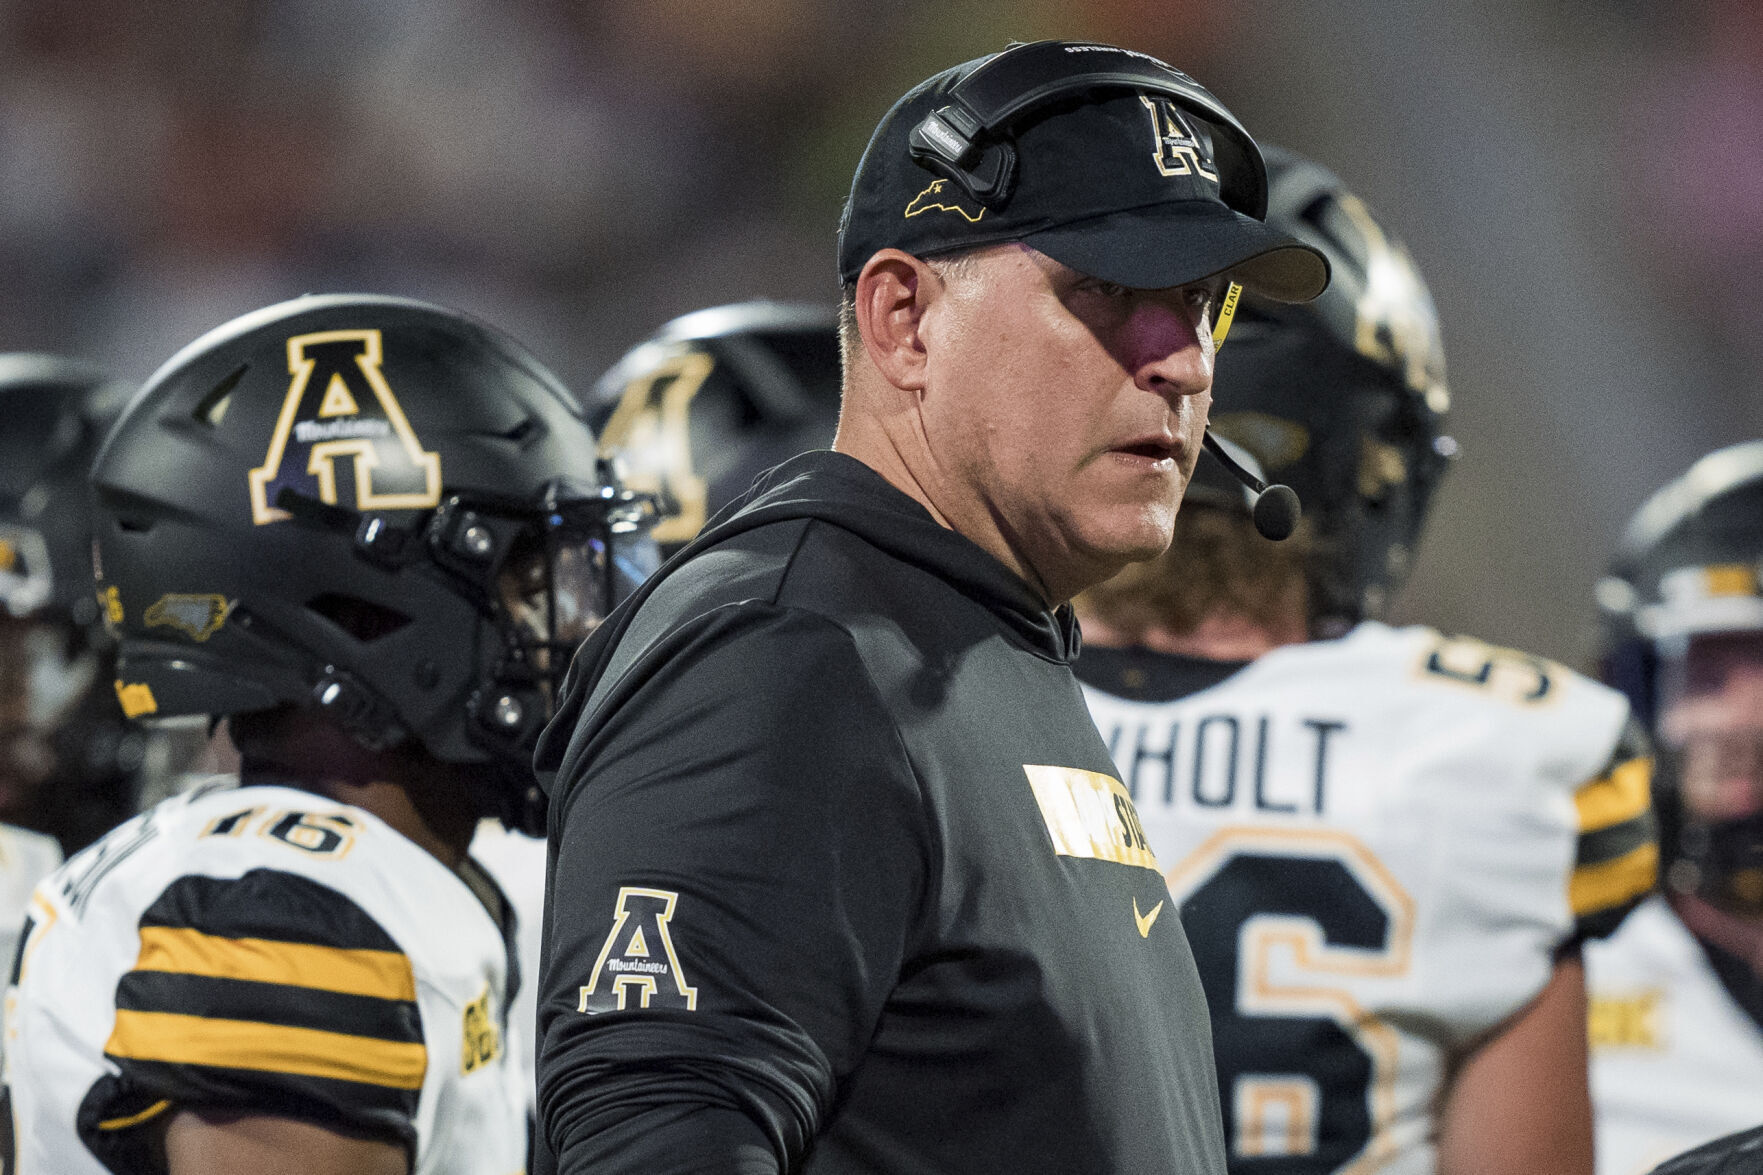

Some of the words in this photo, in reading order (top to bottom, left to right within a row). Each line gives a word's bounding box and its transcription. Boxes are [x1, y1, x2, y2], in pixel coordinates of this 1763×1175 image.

[248, 329, 443, 525] A
[1108, 707, 1348, 816] HOLT
[198, 805, 365, 862] 16
[576, 886, 698, 1014] A
[607, 958, 668, 974] Mountaineers
[1165, 826, 1417, 1175] 6
